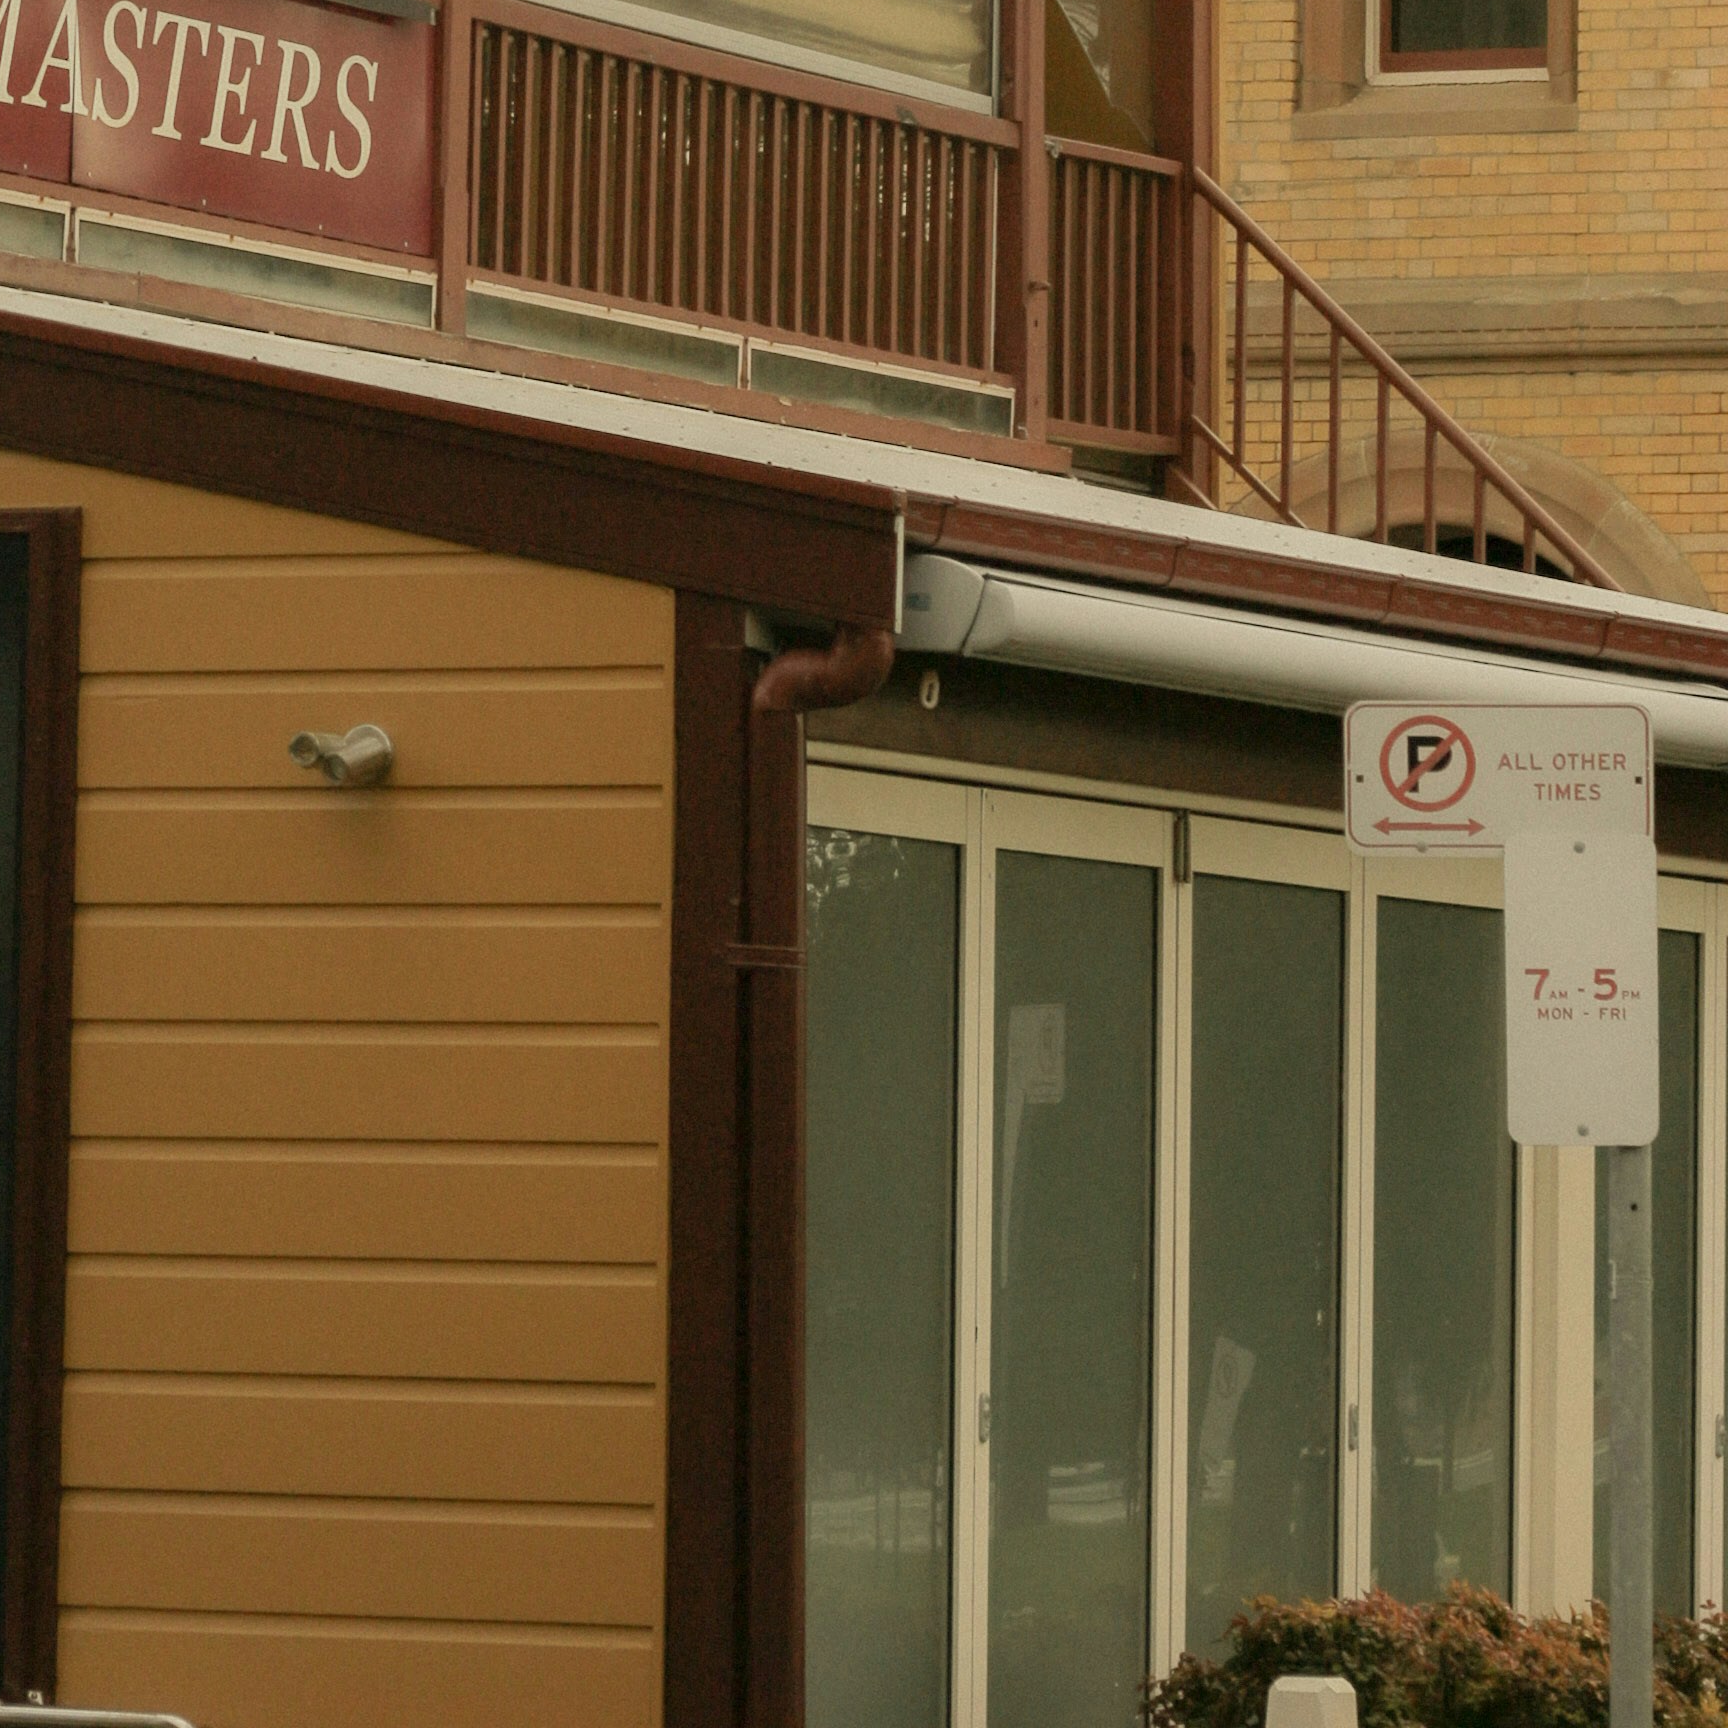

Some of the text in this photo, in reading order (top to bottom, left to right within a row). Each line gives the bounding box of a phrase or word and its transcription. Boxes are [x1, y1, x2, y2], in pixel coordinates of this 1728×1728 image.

[1407, 735, 1453, 793] P
[1498, 752, 1626, 770] ALL OTHER
[1533, 783, 1601, 801] TIMES
[1537, 1007, 1573, 1020] MON
[1599, 1007, 1626, 1020] FRI
